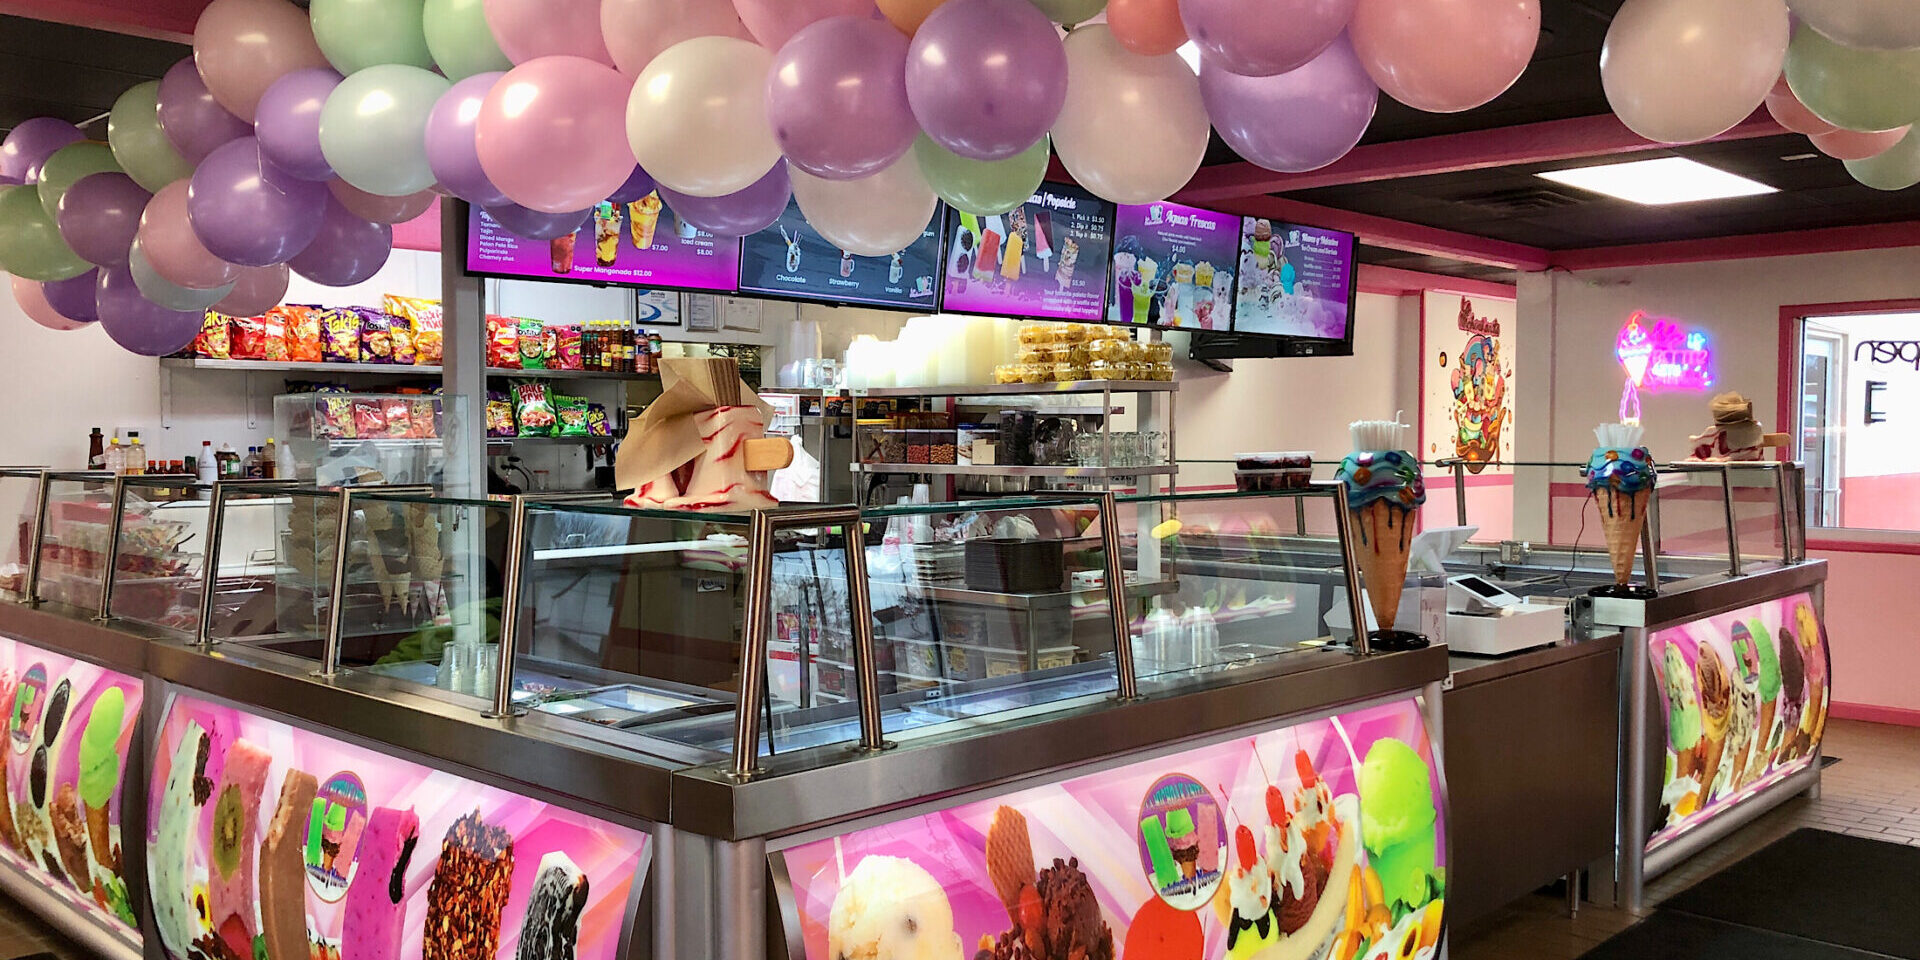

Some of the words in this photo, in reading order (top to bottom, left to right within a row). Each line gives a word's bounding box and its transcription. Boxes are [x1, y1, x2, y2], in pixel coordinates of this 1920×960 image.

[1165, 210, 1188, 227] Aguas
[1190, 214, 1216, 230] Frescas
[1172, 244, 1186, 253] $4.00
[574, 265, 592, 273] Super
[594, 267, 632, 275] Mangonada
[633, 269, 652, 277] $12.00
[776, 273, 806, 284] Chocolate
[829, 277, 859, 288] Strawberry
[885, 286, 903, 294] Vanilla
[325, 311, 360, 336] Takis
[518, 384, 544, 396] PAKE
